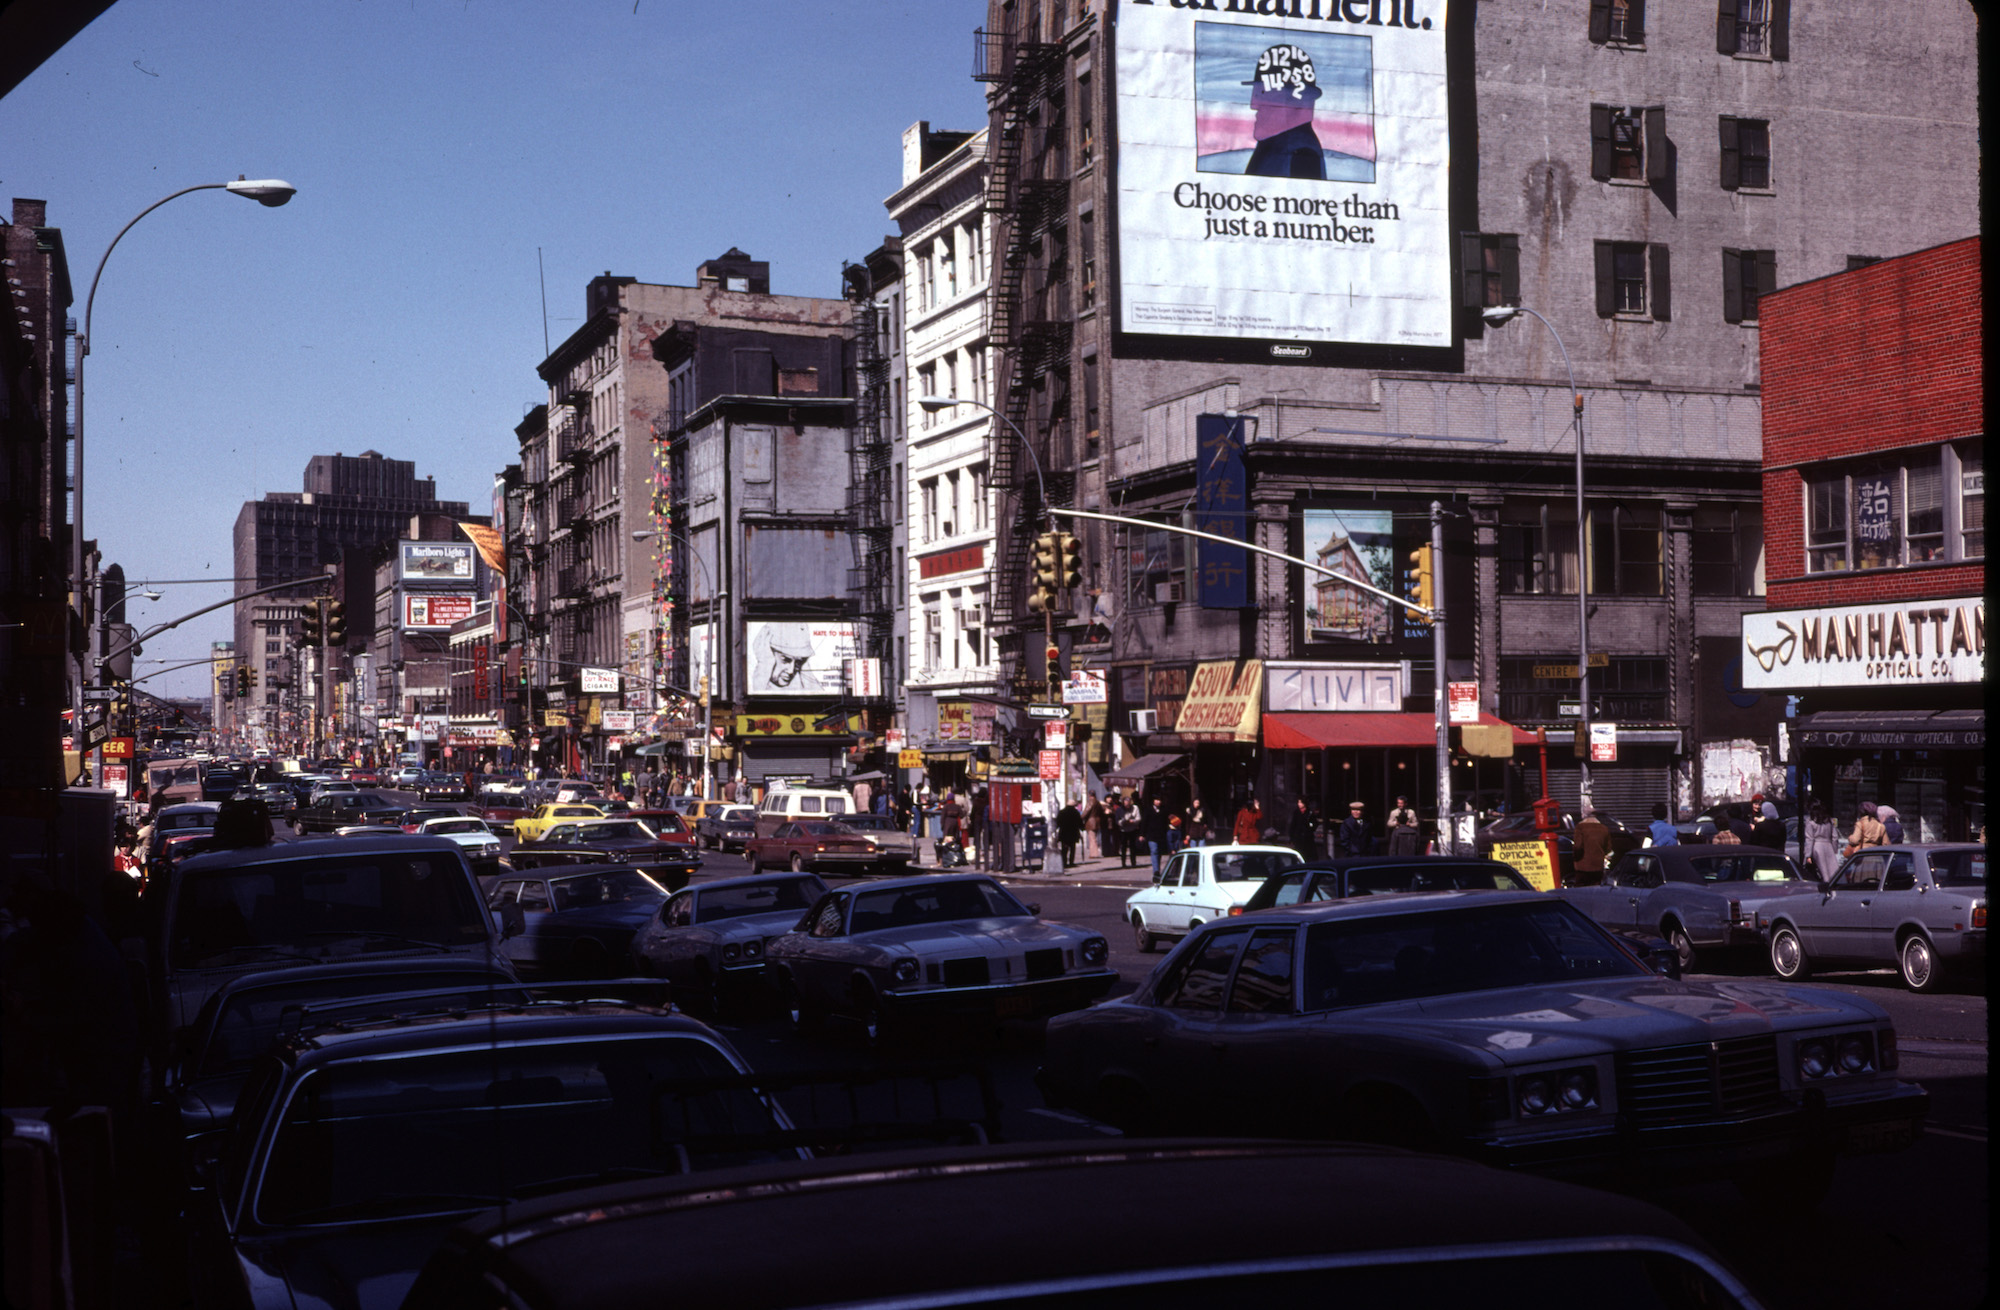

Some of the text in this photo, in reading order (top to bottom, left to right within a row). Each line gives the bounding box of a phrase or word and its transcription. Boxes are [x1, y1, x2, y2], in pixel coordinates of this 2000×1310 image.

[1133, 0, 1432, 30] ament.
[1271, 47, 1291, 67] 12
[1261, 73, 1284, 92] 14
[1302, 64, 1315, 82] 8
[1292, 82, 1306, 100] 2
[1173, 182, 1400, 220] Choose more than
[1204, 210, 1375, 244] just a number.
[412, 547, 466, 558] Marlboro Lights
[477, 650, 487, 697] DRUGS
[1535, 667, 1568, 677] CENTRE
[1866, 659, 1952, 679] OPTICAL CO.
[1562, 706, 1574, 714] ONE
[103, 742, 125, 753] EER
[1859, 732, 1904, 744] MANHATTAN
[1914, 732, 1956, 745] OPTICAL
[1500, 842, 1540, 851] Manhattan
[1500, 851, 1534, 860] OPTICAL
